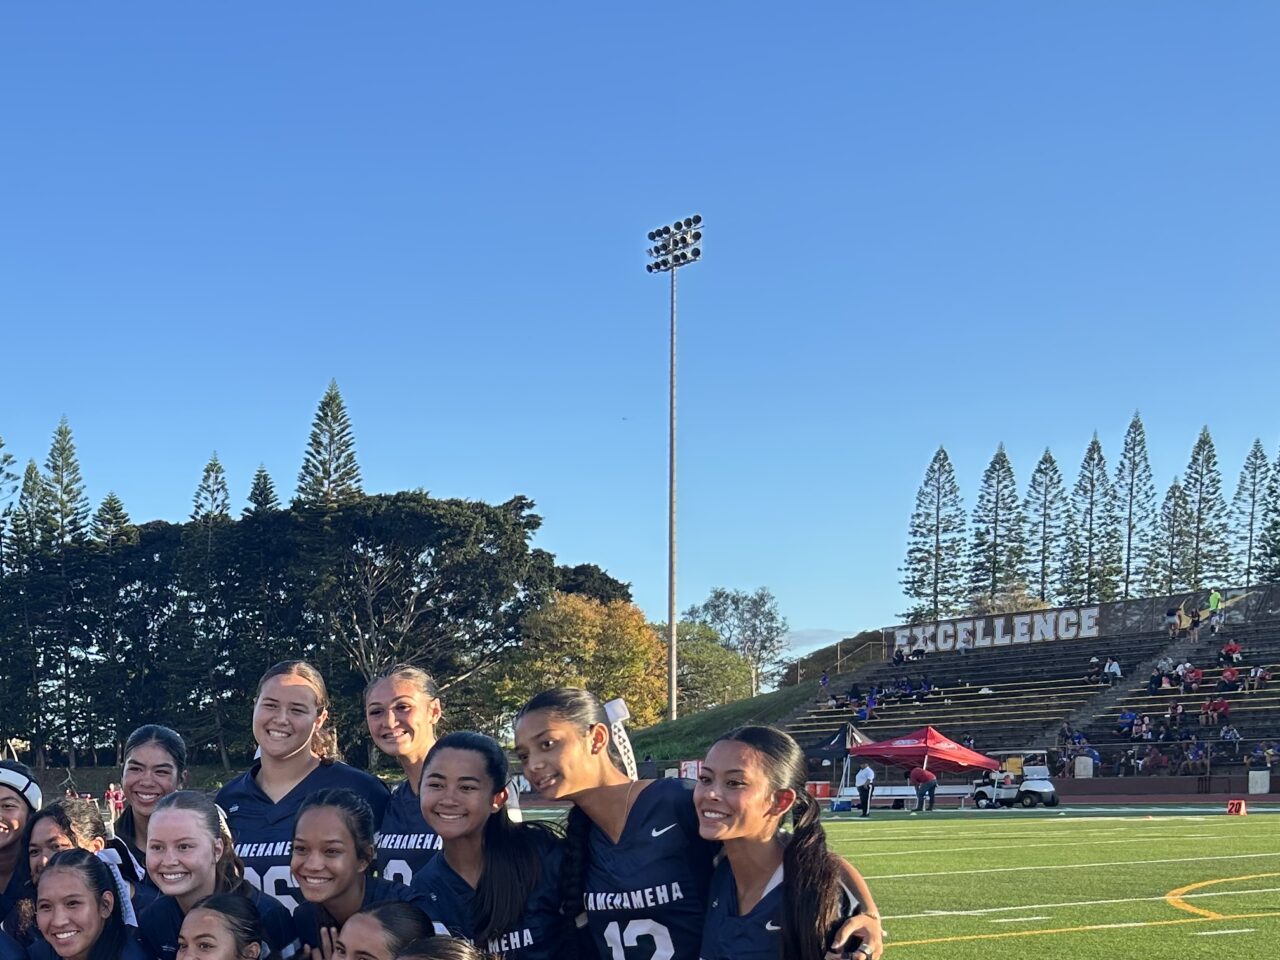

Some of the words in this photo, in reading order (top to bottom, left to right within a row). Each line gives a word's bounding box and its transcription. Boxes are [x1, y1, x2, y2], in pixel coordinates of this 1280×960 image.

[894, 607, 1099, 652] EXCELLENCE
[1228, 802, 1241, 813] 20
[584, 882, 684, 910] AMEHAMEHA
